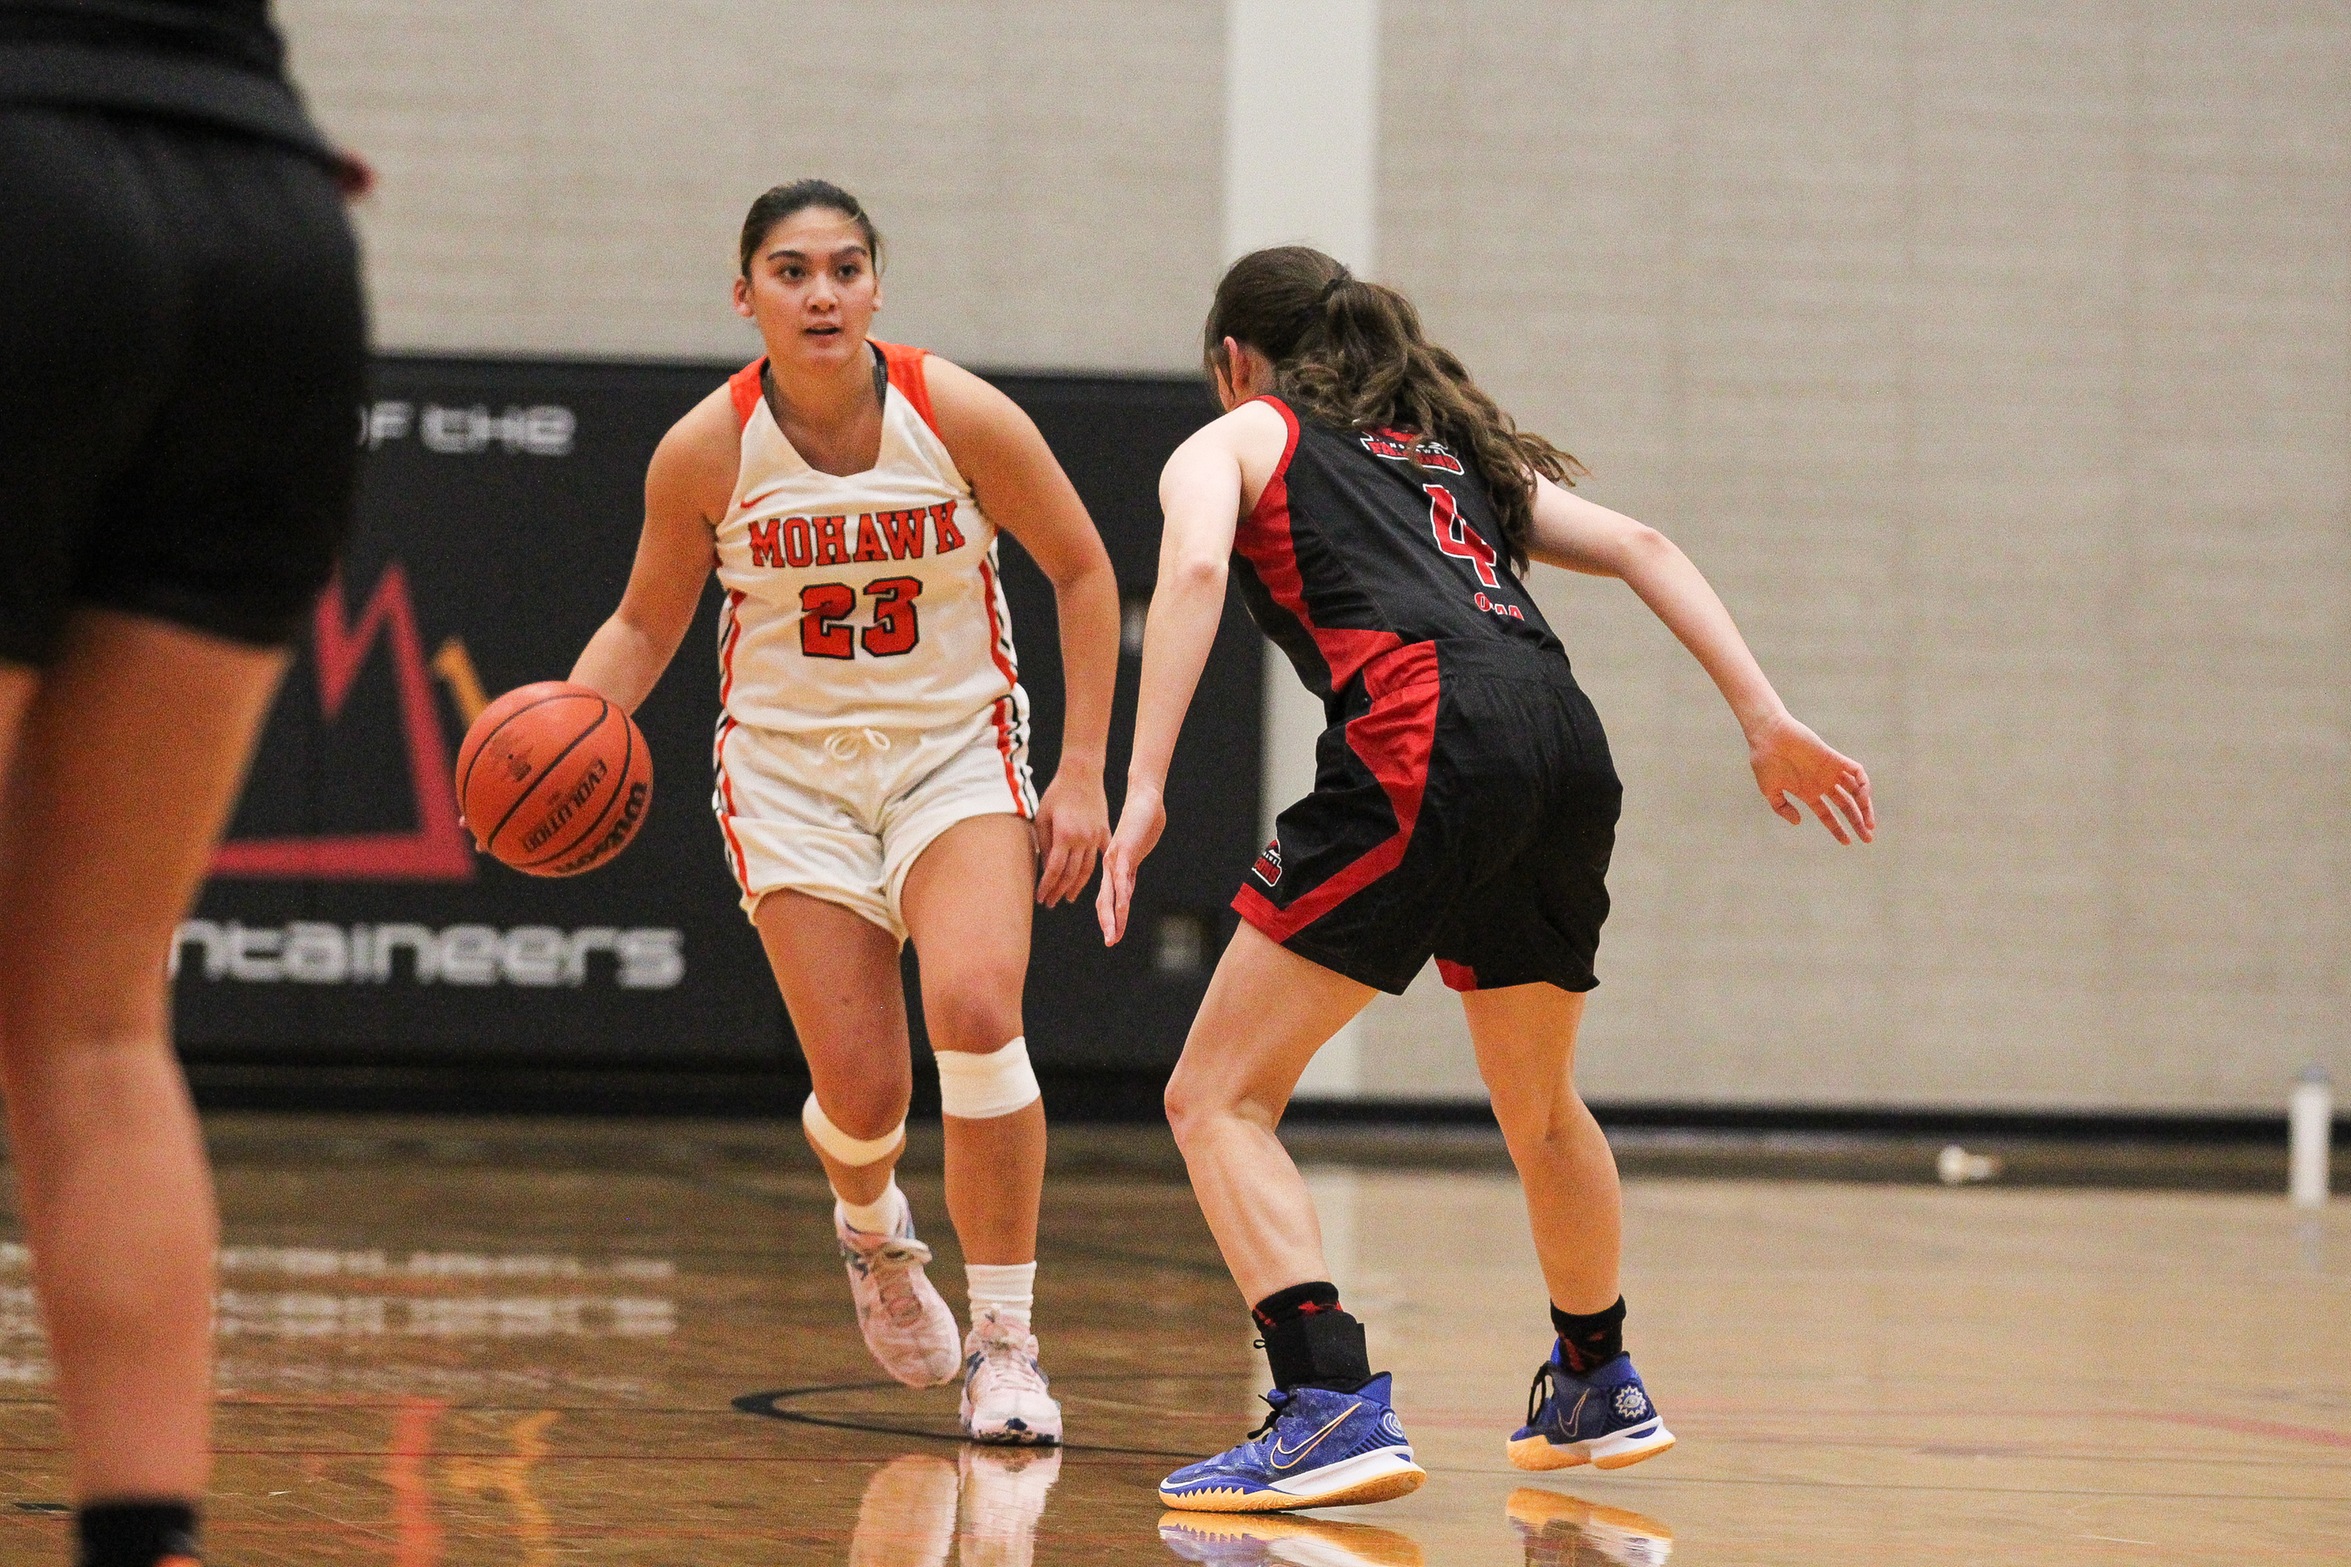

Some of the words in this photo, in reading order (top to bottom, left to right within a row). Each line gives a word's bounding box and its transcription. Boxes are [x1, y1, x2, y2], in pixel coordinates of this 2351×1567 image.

[748, 499, 966, 568] MOHAWK
[1423, 483, 1501, 589] 4
[799, 575, 923, 660] 23
[523, 758, 608, 854] EVOLUTION
[168, 918, 685, 990] ntaineers
